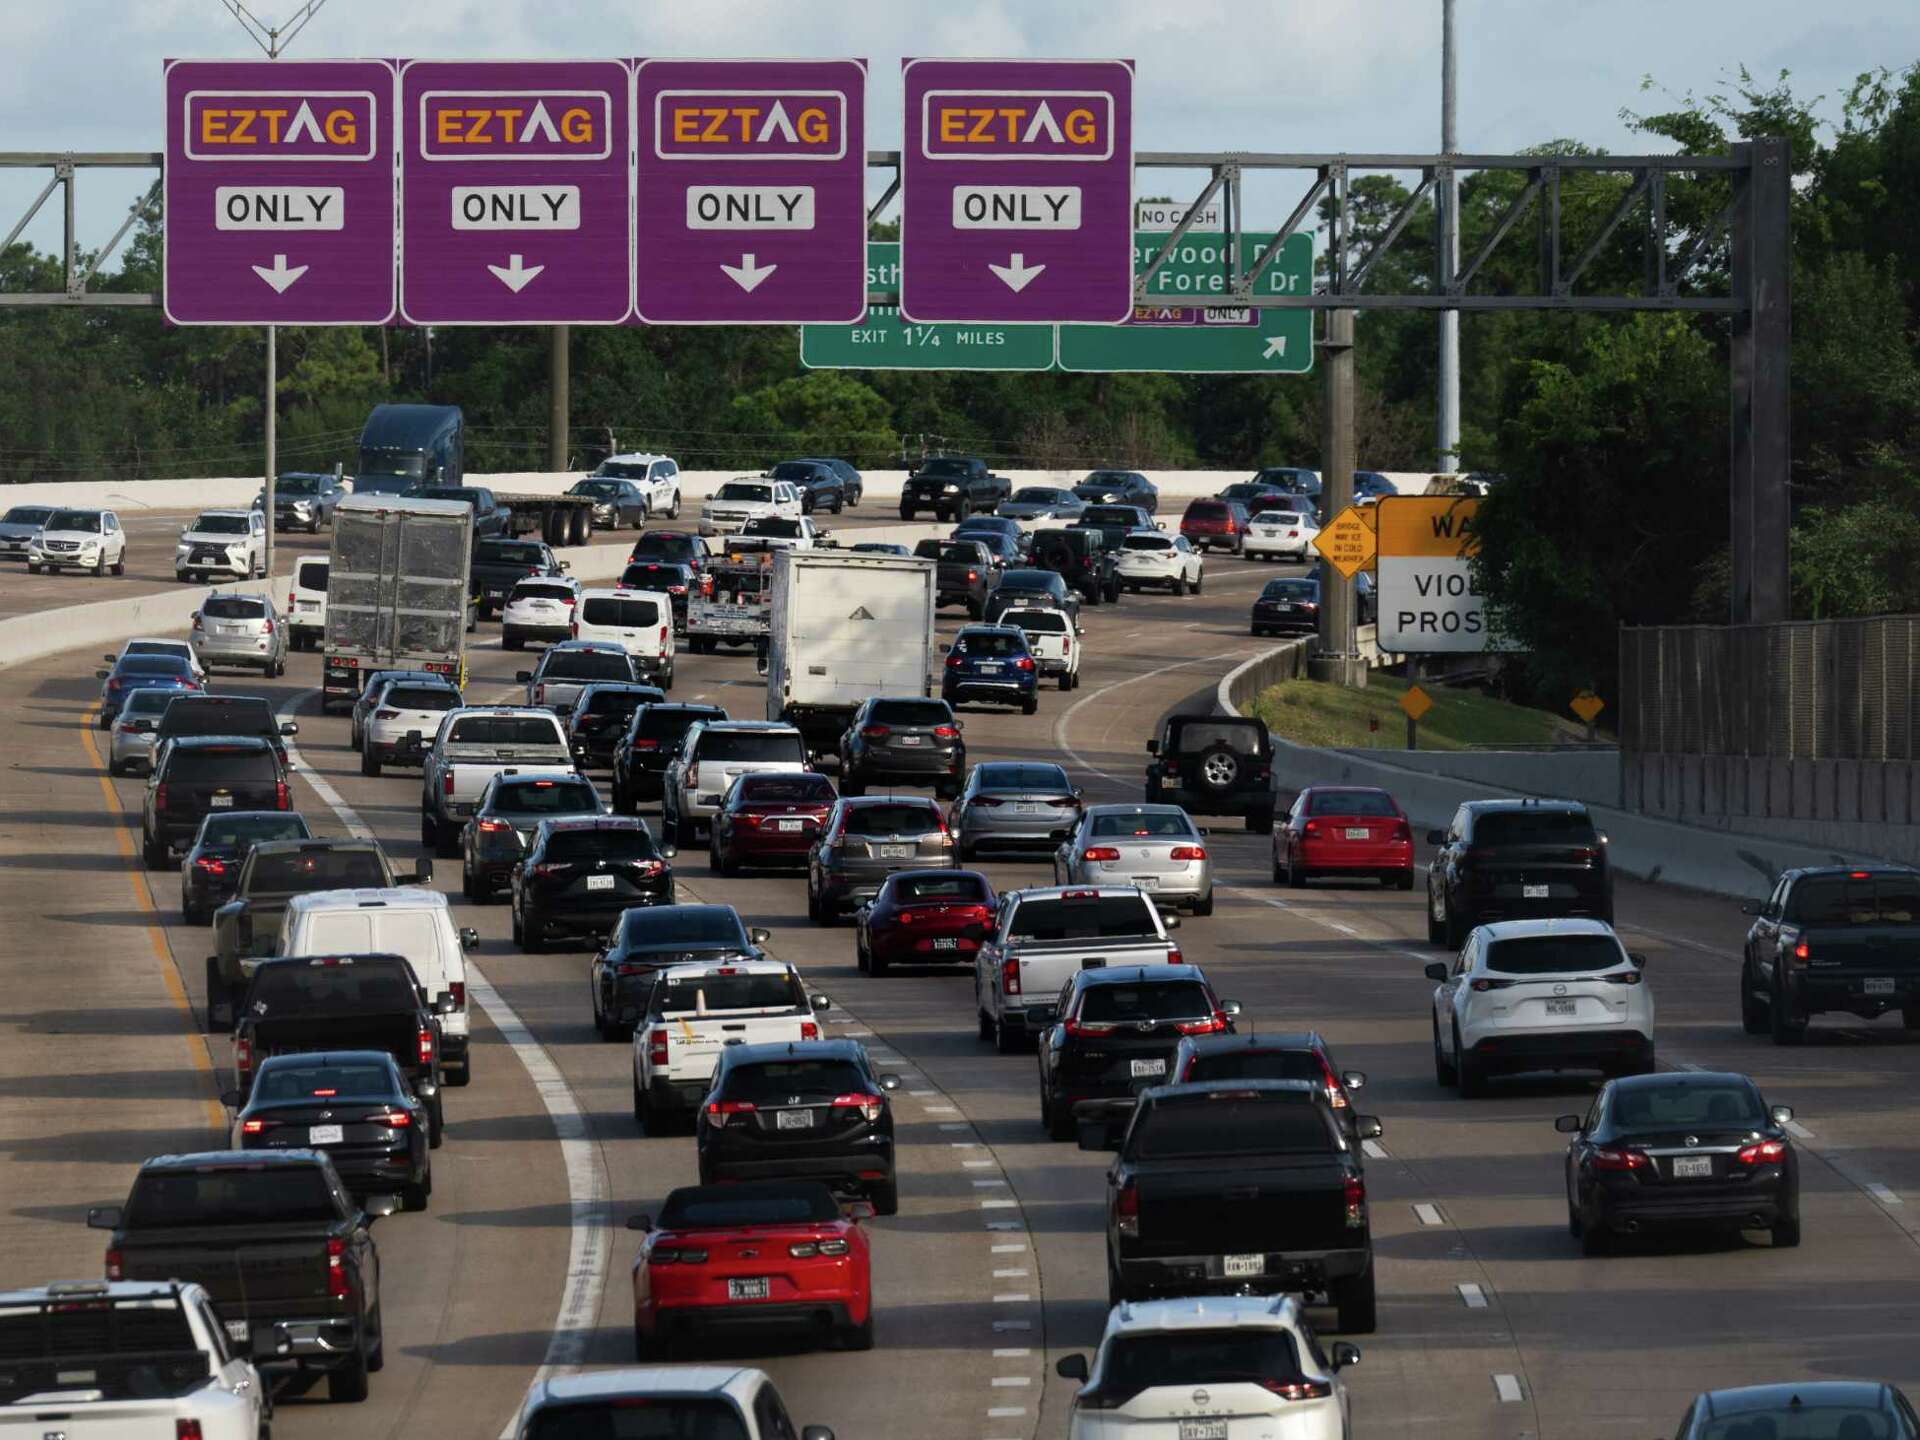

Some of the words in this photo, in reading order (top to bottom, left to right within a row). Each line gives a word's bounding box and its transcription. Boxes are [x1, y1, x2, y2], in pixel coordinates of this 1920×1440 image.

[202, 100, 356, 144] EZTAG
[437, 100, 593, 144] EZTAG
[674, 100, 829, 144] EZTAG
[940, 100, 1096, 144] EZTAG
[226, 194, 332, 223] ONLY
[463, 193, 569, 222] ONLY
[697, 193, 803, 223] ONLY
[963, 193, 1070, 223] ONLY
[1142, 210, 1165, 224] NO
[1170, 210, 1217, 224] CSH
[1158, 271, 1248, 291] Fore
[1271, 271, 1299, 291] Dr
[1207, 308, 1246, 320] ONLY
[851, 330, 887, 343] EXIT
[957, 331, 1005, 345] MILES
